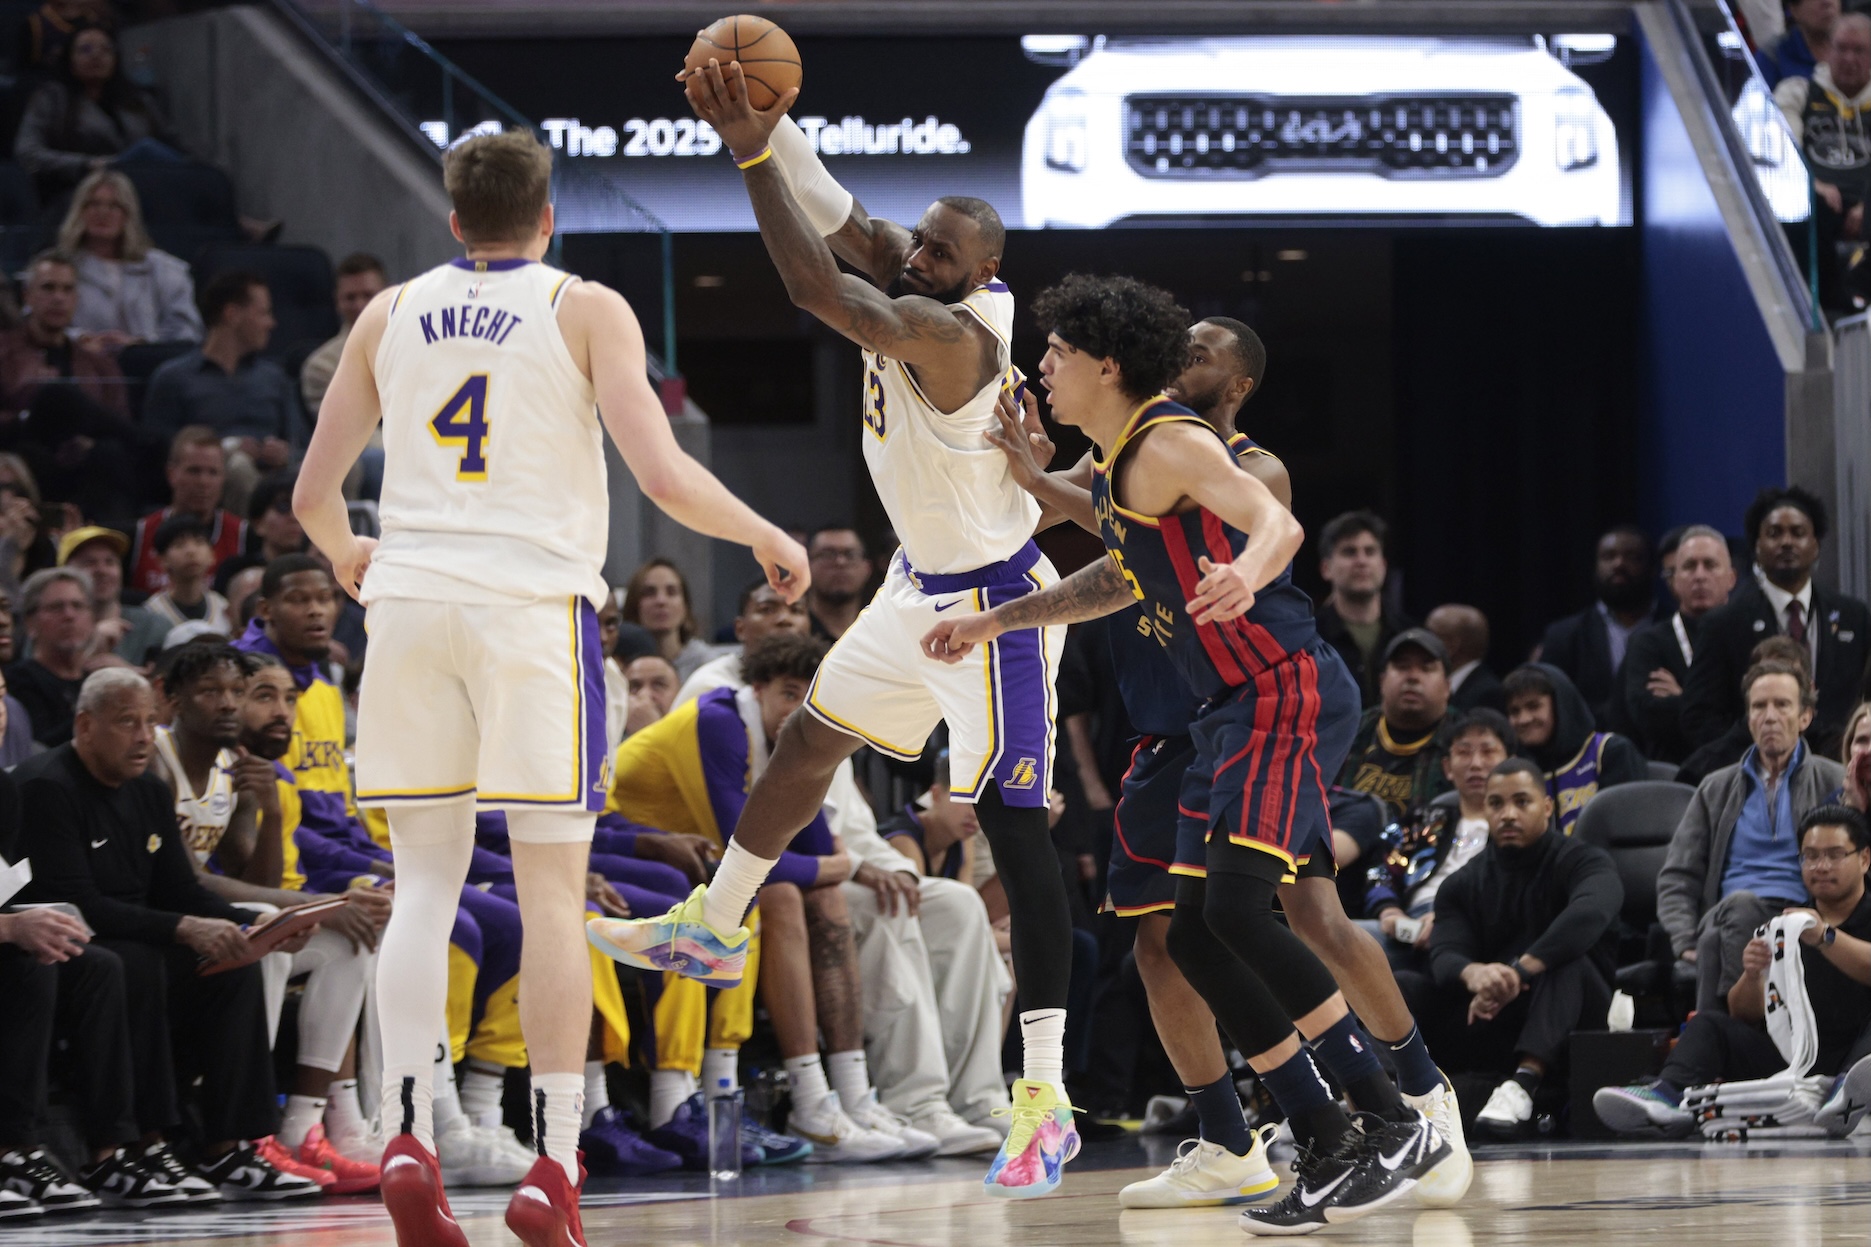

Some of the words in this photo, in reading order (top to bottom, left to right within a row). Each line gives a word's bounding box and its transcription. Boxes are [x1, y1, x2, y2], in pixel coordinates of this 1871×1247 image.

[540, 118, 619, 157] The
[623, 117, 722, 156] 2025
[797, 116, 972, 155] Telluride.
[419, 304, 523, 346] KNECHT
[426, 371, 492, 482] 4
